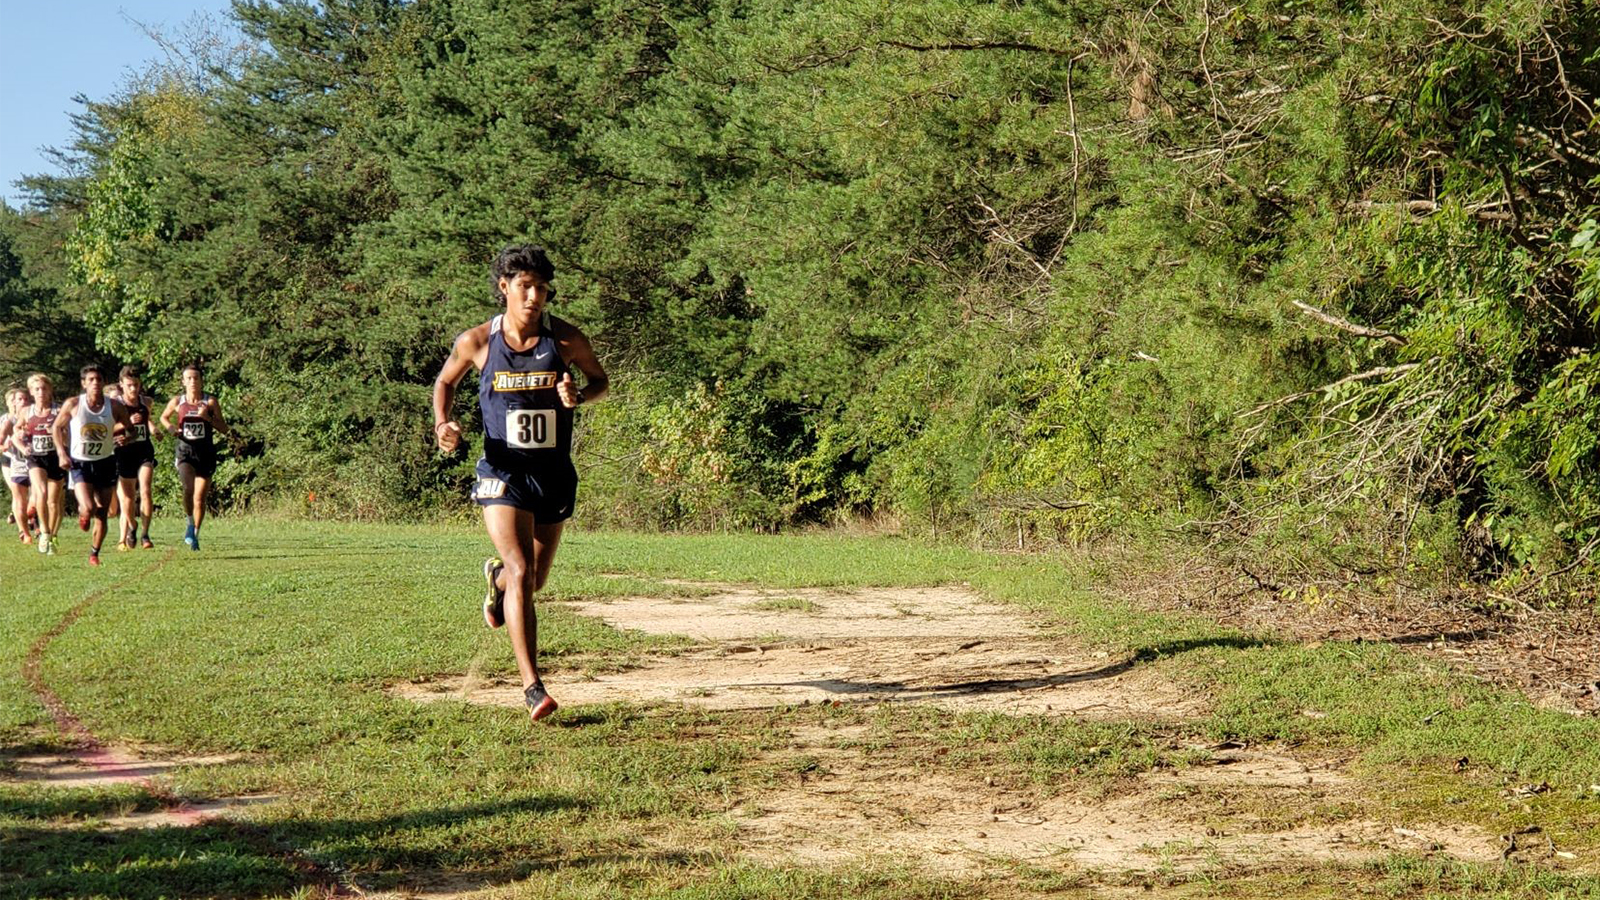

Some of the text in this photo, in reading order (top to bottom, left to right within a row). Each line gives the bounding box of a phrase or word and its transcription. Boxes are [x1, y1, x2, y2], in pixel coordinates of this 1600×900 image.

[184, 423, 204, 437] 222
[517, 413, 547, 444] 30
[82, 442, 103, 456] 122
